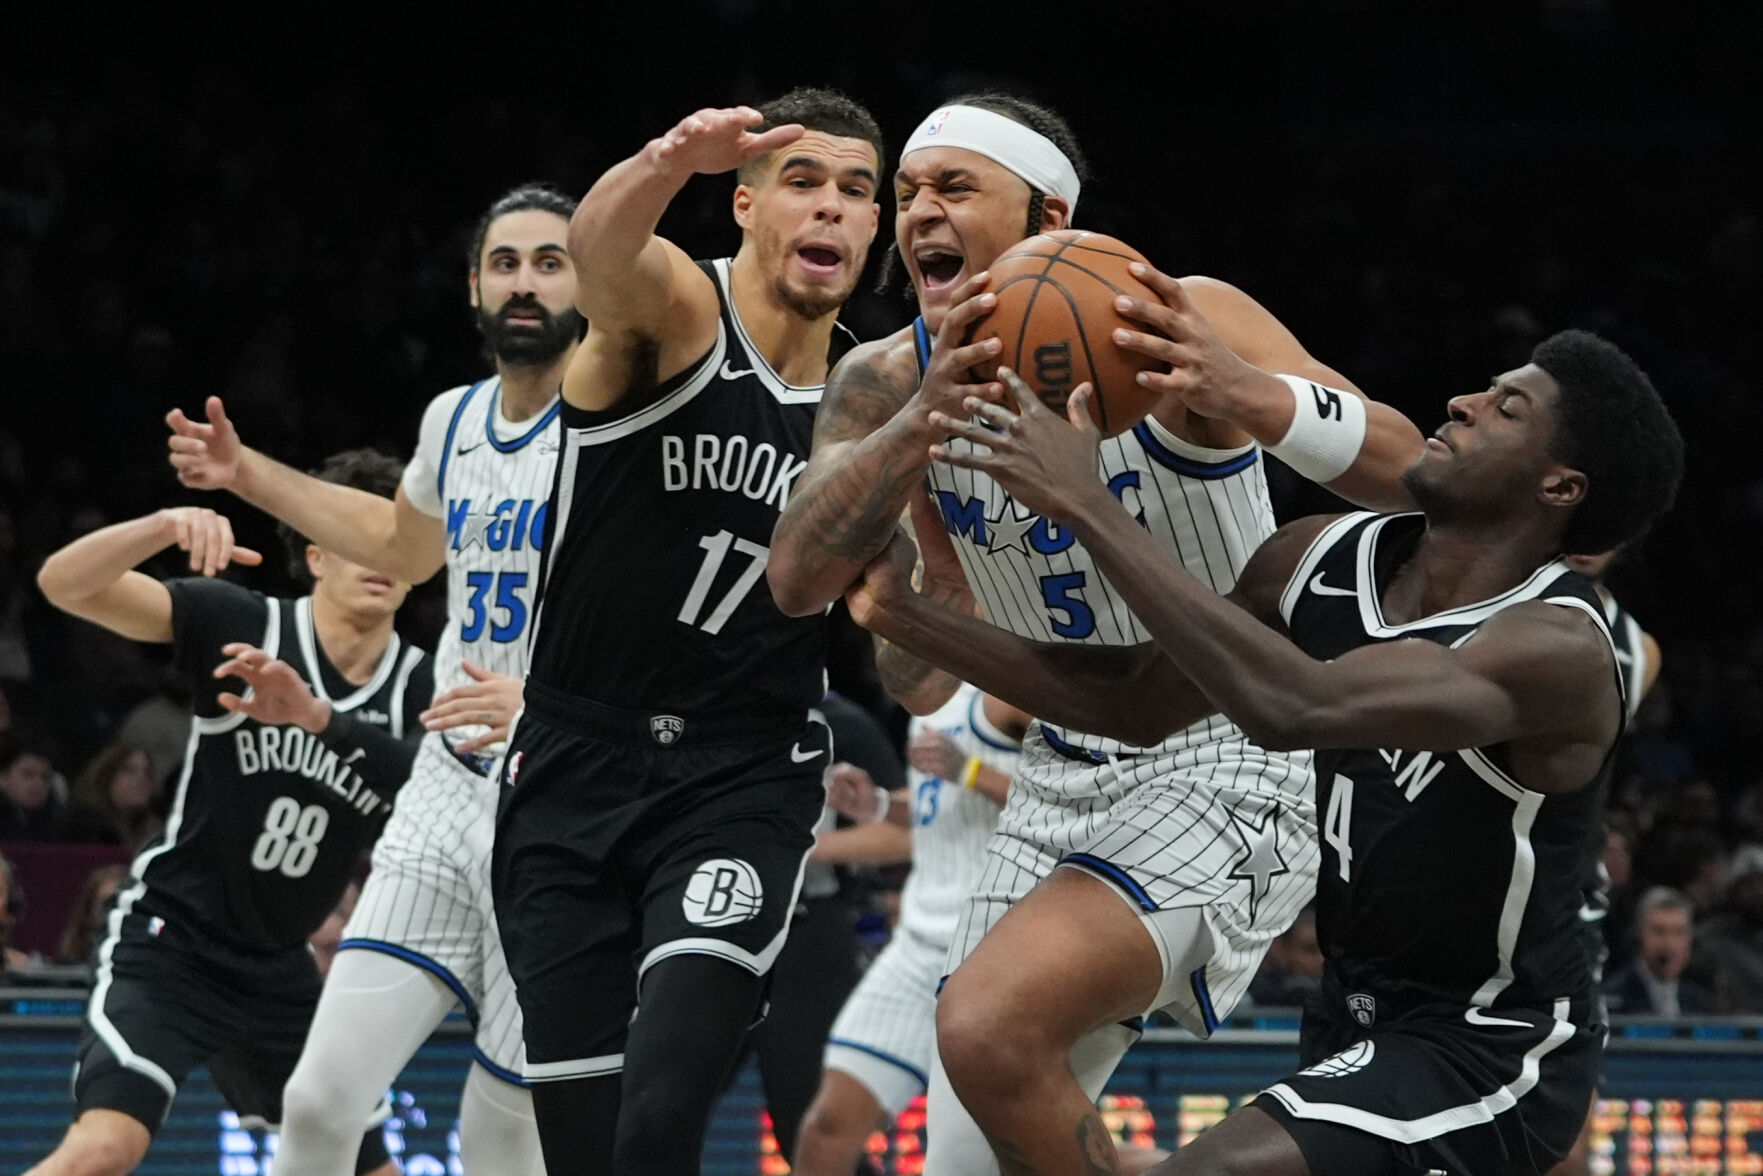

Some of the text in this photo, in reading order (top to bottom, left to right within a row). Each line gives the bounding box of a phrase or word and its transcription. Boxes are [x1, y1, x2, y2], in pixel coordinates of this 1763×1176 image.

[460, 571, 528, 644] 35
[677, 528, 771, 636] 17
[1039, 570, 1096, 640] 5
[653, 719, 681, 731] NETS
[252, 796, 330, 878] 88
[1324, 772, 1354, 883] 4
[703, 867, 738, 917] B
[1349, 997, 1374, 1011] NETS
